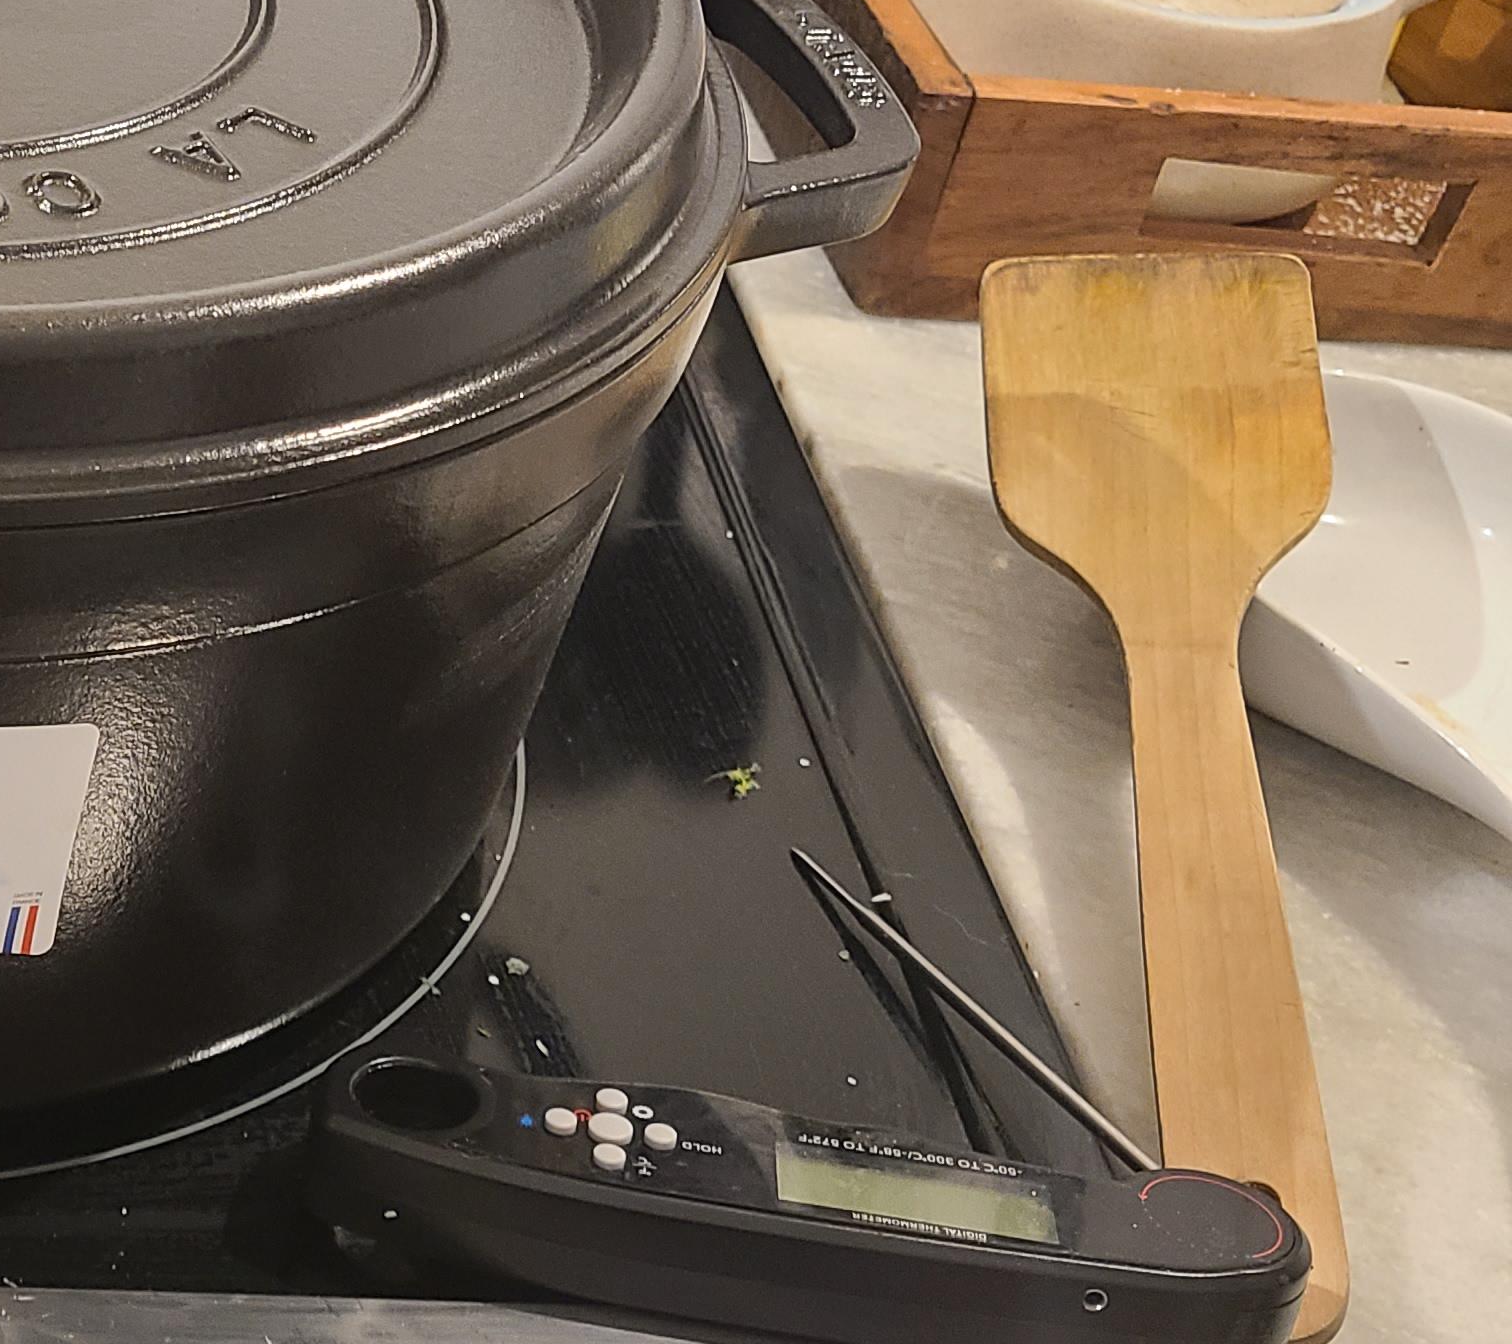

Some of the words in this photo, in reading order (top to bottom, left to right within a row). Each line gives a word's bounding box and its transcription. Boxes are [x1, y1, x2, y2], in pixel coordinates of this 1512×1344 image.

[148, 107, 317, 182] LA
[681, 1140, 723, 1155] HOLD
[843, 1141, 865, 1153] TO
[957, 1158, 981, 1171] TO
[851, 1211, 941, 1235] THERMOMETER
[942, 1227, 988, 1243] DIGITAL
